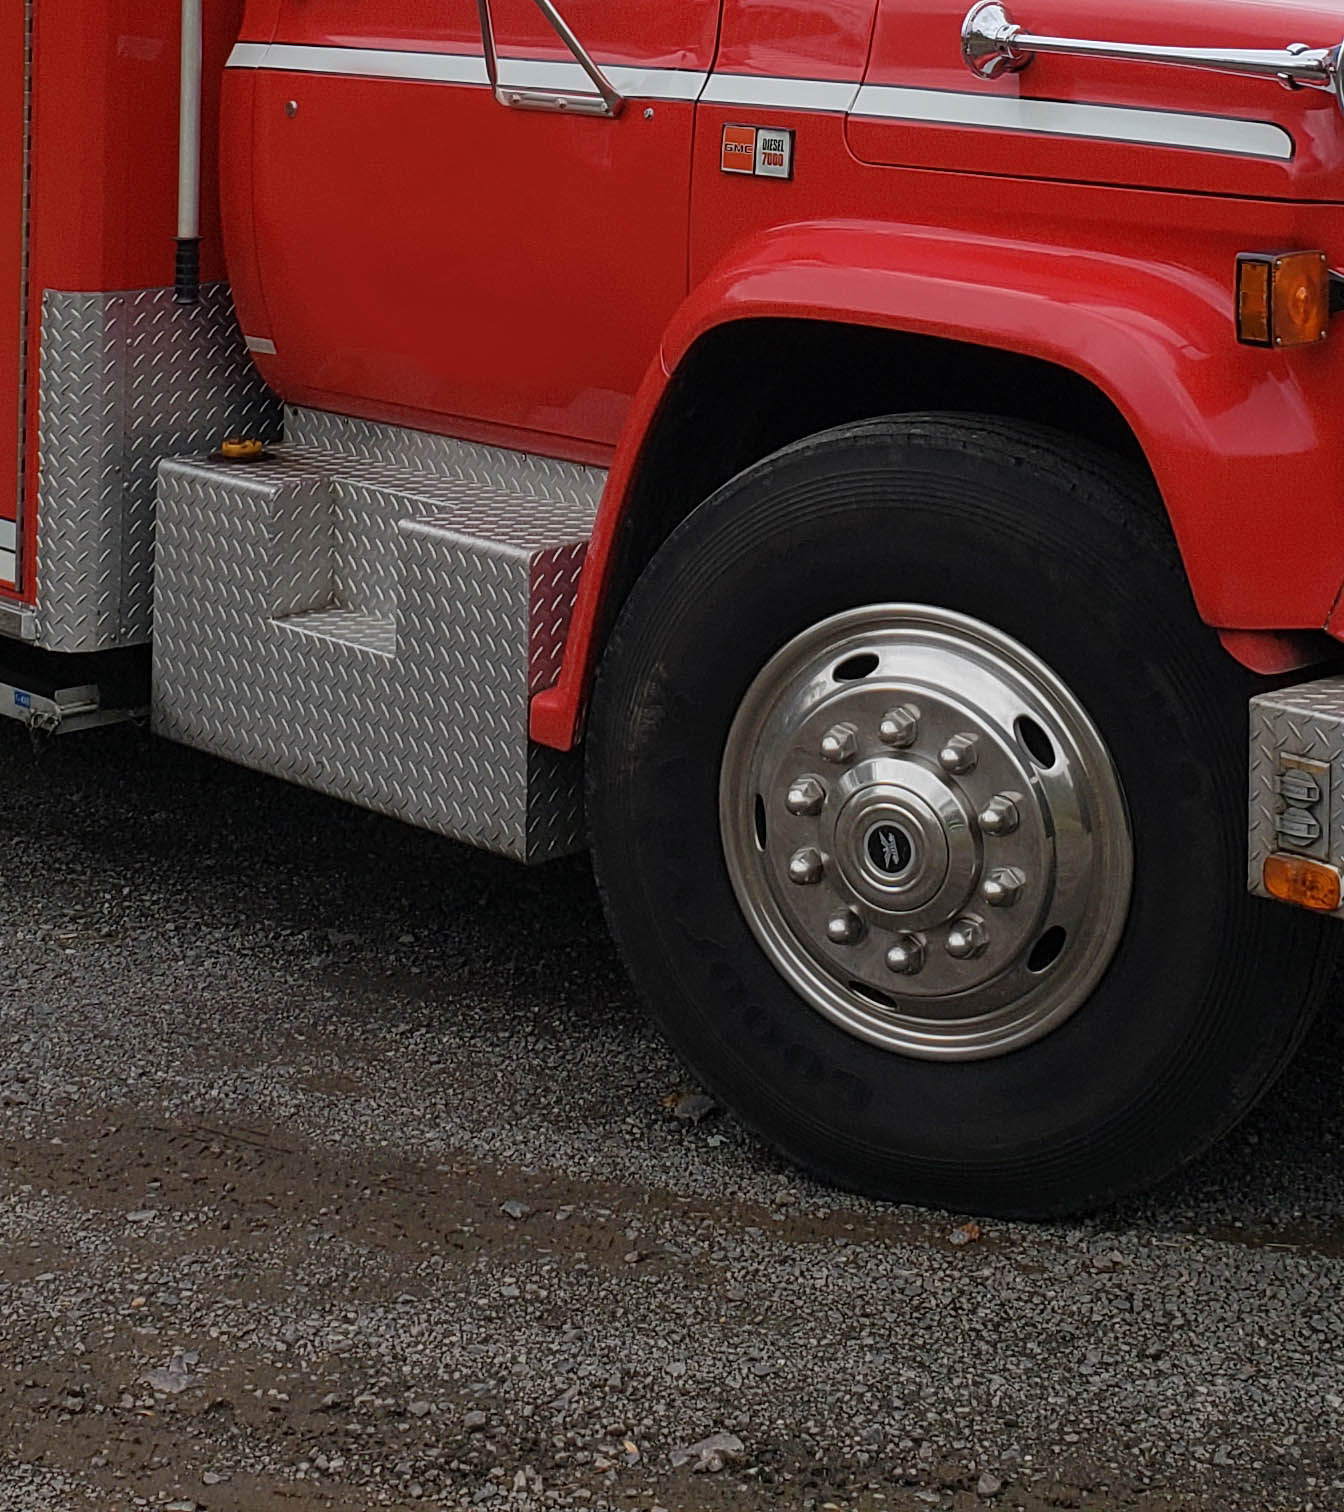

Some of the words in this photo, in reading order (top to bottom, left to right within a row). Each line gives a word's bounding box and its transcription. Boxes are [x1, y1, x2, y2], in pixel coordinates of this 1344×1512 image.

[724, 142, 753, 154] GMC
[762, 138, 784, 152] DIESEL
[762, 152, 784, 167] 7000
